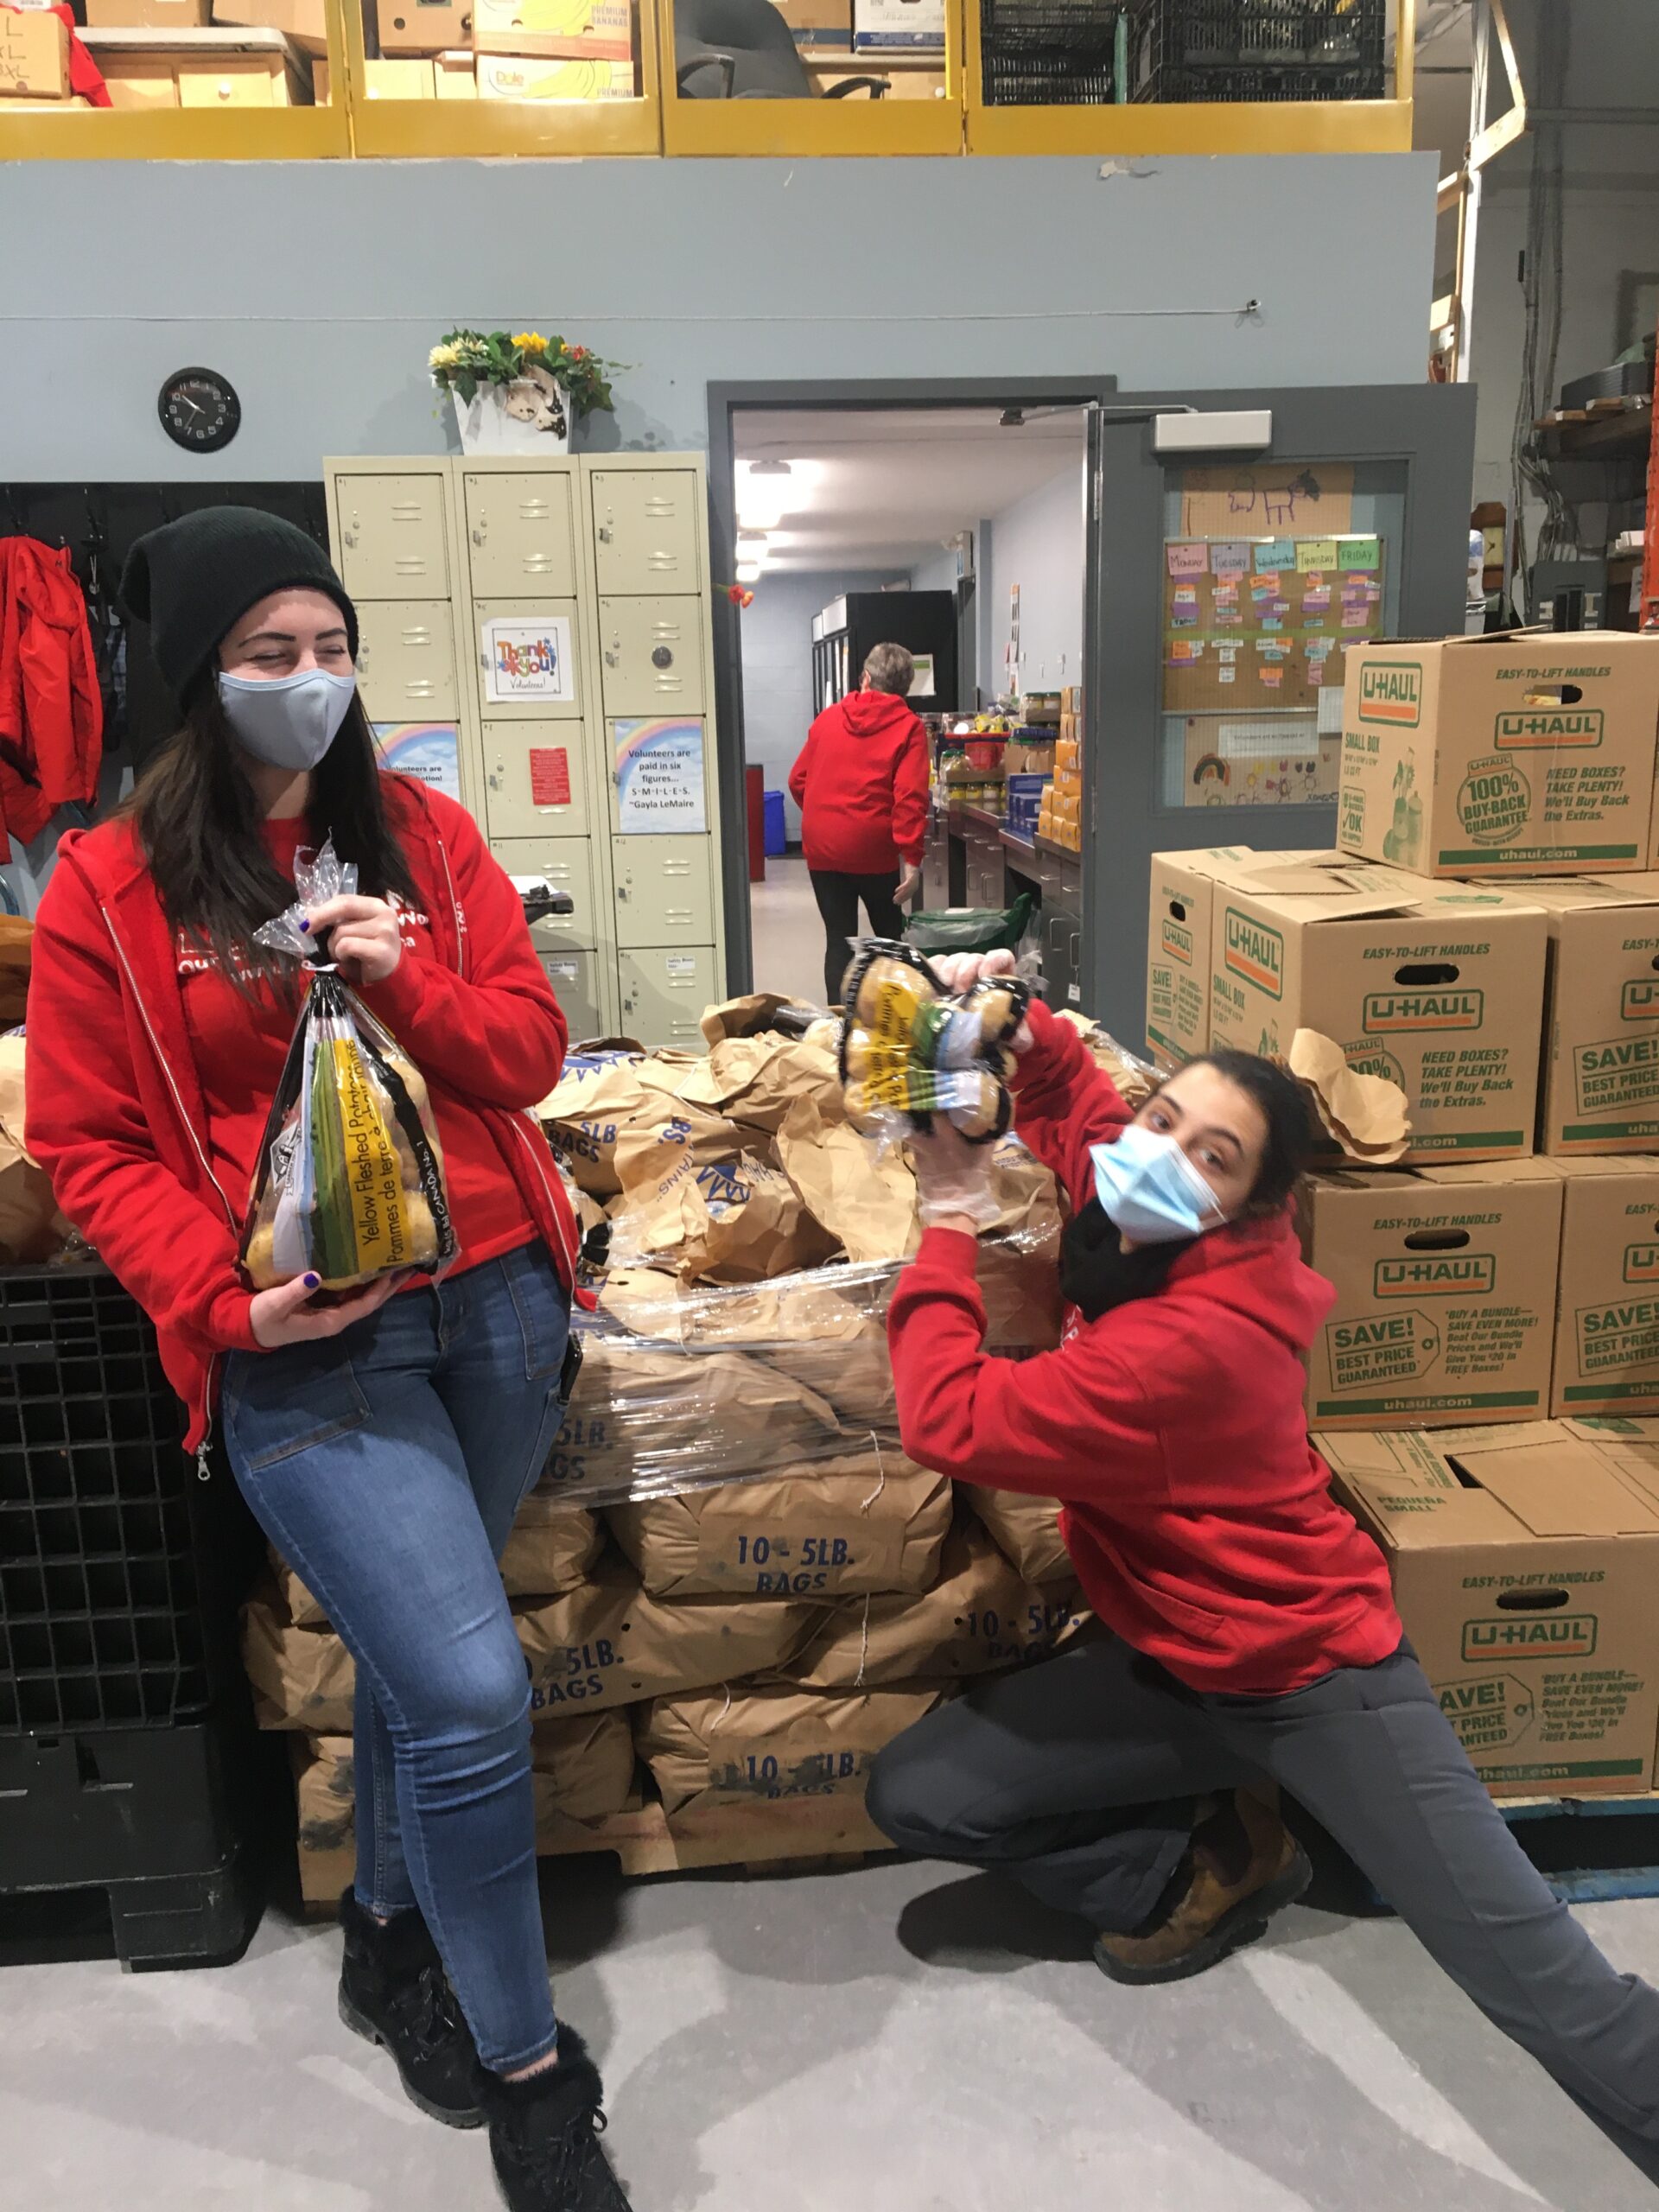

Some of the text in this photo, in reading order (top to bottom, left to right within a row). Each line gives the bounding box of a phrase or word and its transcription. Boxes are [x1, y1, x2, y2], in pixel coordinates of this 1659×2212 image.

[592, 6, 627, 16] PREMIUM
[1341, 548, 1374, 562] FRIDAY
[497, 639, 550, 662] Thank
[518, 655, 556, 677] you!
[1496, 666, 1611, 680] EASY-TO-LIFT HANDLES
[1363, 672, 1418, 702] U-HAUL
[1503, 716, 1596, 734] U-HAUL
[1345, 732, 1380, 753] SMALL BOX
[629, 749, 691, 759] Volunteers are
[639, 761, 681, 772] paid in six
[1471, 757, 1510, 771] U-HAUL
[1545, 766, 1626, 780] NEED BOXES?
[642, 774, 679, 784] figures...
[1467, 771, 1520, 802] 100%
[1547, 780, 1624, 794] TAKE PLENTY!
[660, 799, 695, 809] LeMaire
[1464, 794, 1526, 820] BUY-BACK
[1545, 794, 1630, 809] We'll Buy Back
[1349, 813, 1363, 833] OK
[1465, 812, 1528, 835] GUARANTEE
[1544, 810, 1605, 822] the Extras.
[1500, 849, 1578, 860] uhaul.com
[1164, 926, 1191, 952] U-HAUL
[1229, 918, 1280, 973] U-HAUL
[1363, 943, 1491, 959] EASY-TO-LIFT HANDLES
[1153, 969, 1173, 988] SAVE!
[1213, 974, 1232, 1001] SMALL
[1233, 987, 1246, 1010] BOX
[1372, 996, 1475, 1018] U-HAUL
[1421, 1048, 1509, 1065] NEED BOXES?
[1582, 1039, 1658, 1071] SAVE!
[1421, 1064, 1507, 1078] TAKE PLENTY!
[1421, 1078, 1514, 1094] We'll Buy Back
[1583, 1069, 1658, 1094] BEST PRICE
[1420, 1095, 1486, 1109] the Extras.
[548, 1129, 601, 1164] BAGS
[349, 1132, 374, 1192] Fleshed
[378, 1143, 394, 1178] terre
[380, 1180, 397, 1201] de
[425, 1167, 446, 1215] CANADA
[358, 1195, 379, 1246] Yellow
[1373, 1213, 1503, 1230] EASY-TO-LIFT HANDLES
[386, 1205, 404, 1263] Pommes
[1382, 1261, 1487, 1283] U-HAUL
[1471, 1309, 1478, 1319] A
[1335, 1317, 1414, 1348] SAVE!
[1447, 1317, 1539, 1332] SAVE EVEN MORE!
[1447, 1331, 1523, 1342] Beat Our Bundle
[1446, 1340, 1523, 1353] Prices and We'll
[1585, 1338, 1618, 1356] BEST
[1336, 1346, 1414, 1370] BEST PRICE
[1446, 1355, 1466, 1363] Give
[1470, 1353, 1486, 1363] You
[1337, 1361, 1417, 1384] GUARANTEED
[1445, 1363, 1504, 1375] FREE Boxes!
[1384, 1398, 1472, 1410] uhaul.com
[1377, 1497, 1447, 1505] PEQUEÑA
[738, 1535, 770, 1565] 10
[800, 1538, 855, 1566] 5LB.
[756, 1571, 828, 1593] BAGS
[1462, 1571, 1605, 1588] EASY-TO-LIFT HANDLES
[968, 1611, 999, 1637] 10
[1472, 1622, 1588, 1645] U-HAUL
[566, 1639, 625, 1676] 5LB.
[531, 1674, 603, 1711] BAGS
[1440, 1682, 1505, 1711] AVE!
[1574, 1683, 1604, 1694] EVEN
[1462, 1713, 1506, 1732] PRICE
[747, 1755, 778, 1783] 10
